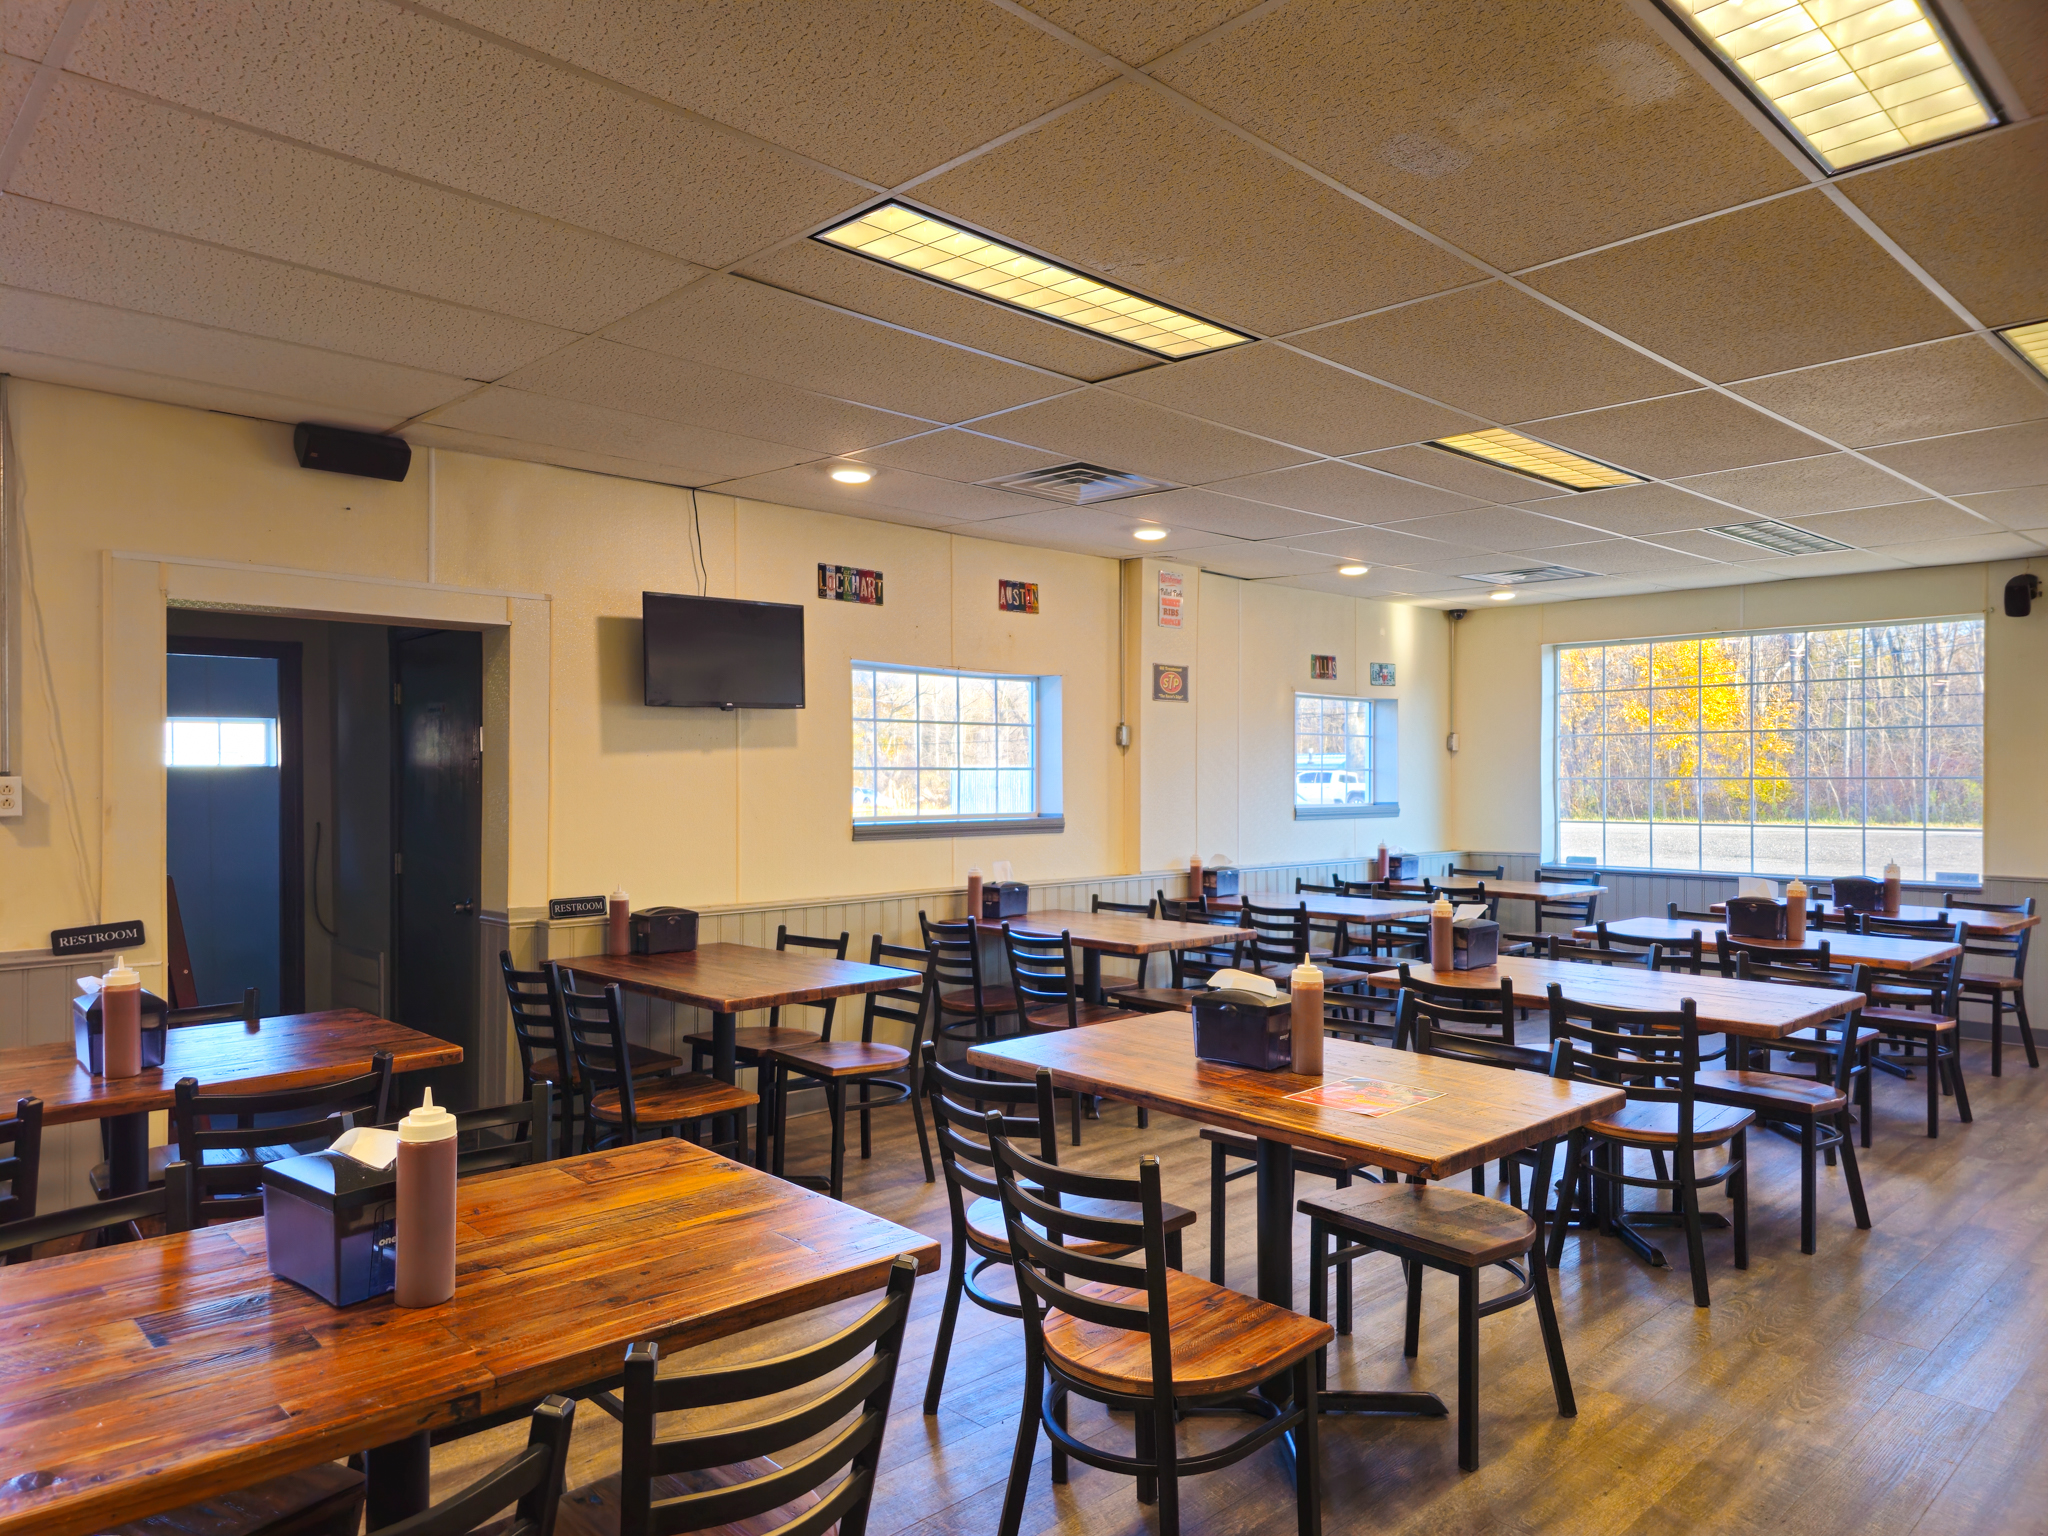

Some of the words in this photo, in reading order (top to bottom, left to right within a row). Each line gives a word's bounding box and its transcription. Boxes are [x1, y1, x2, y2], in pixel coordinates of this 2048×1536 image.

[818, 569, 883, 599] LOCKHART
[1000, 586, 1039, 606] AUSTIN
[1163, 607, 1179, 617] RIBS
[1163, 674, 1180, 690] STP
[554, 901, 603, 913] RESTROOM
[59, 928, 138, 947] RESTROOM
